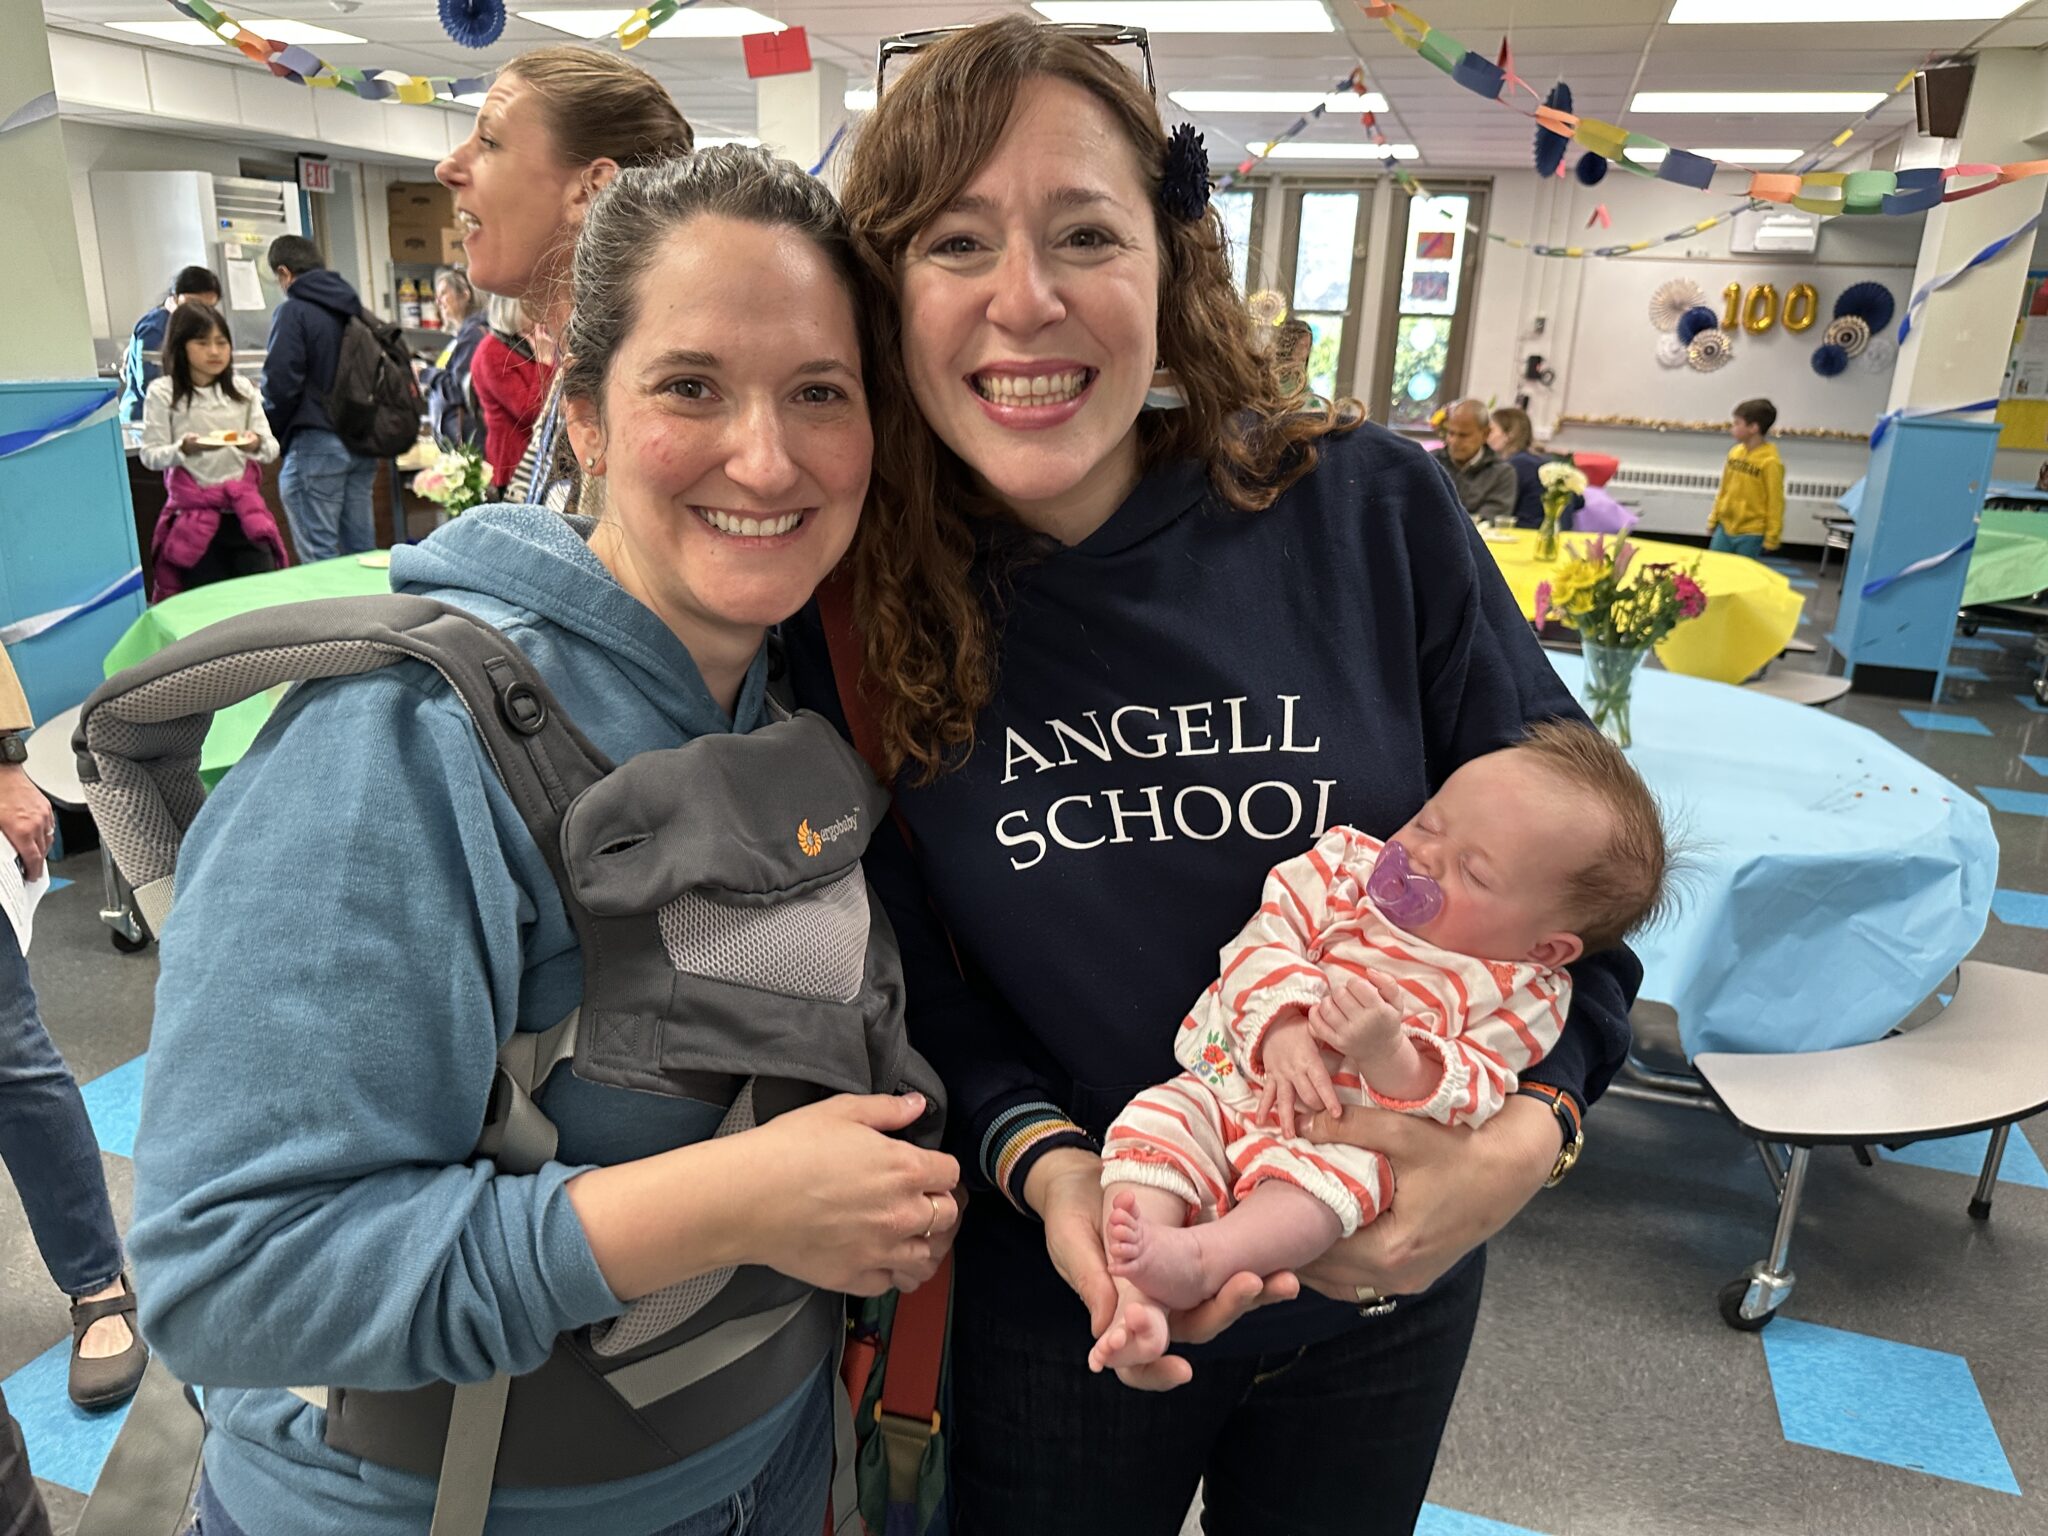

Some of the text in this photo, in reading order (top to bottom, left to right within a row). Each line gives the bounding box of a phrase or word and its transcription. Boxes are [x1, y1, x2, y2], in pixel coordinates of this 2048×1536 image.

[305, 160, 330, 189] EXIT
[1721, 282, 1818, 335] 100
[1001, 694, 1320, 784] ANGELL
